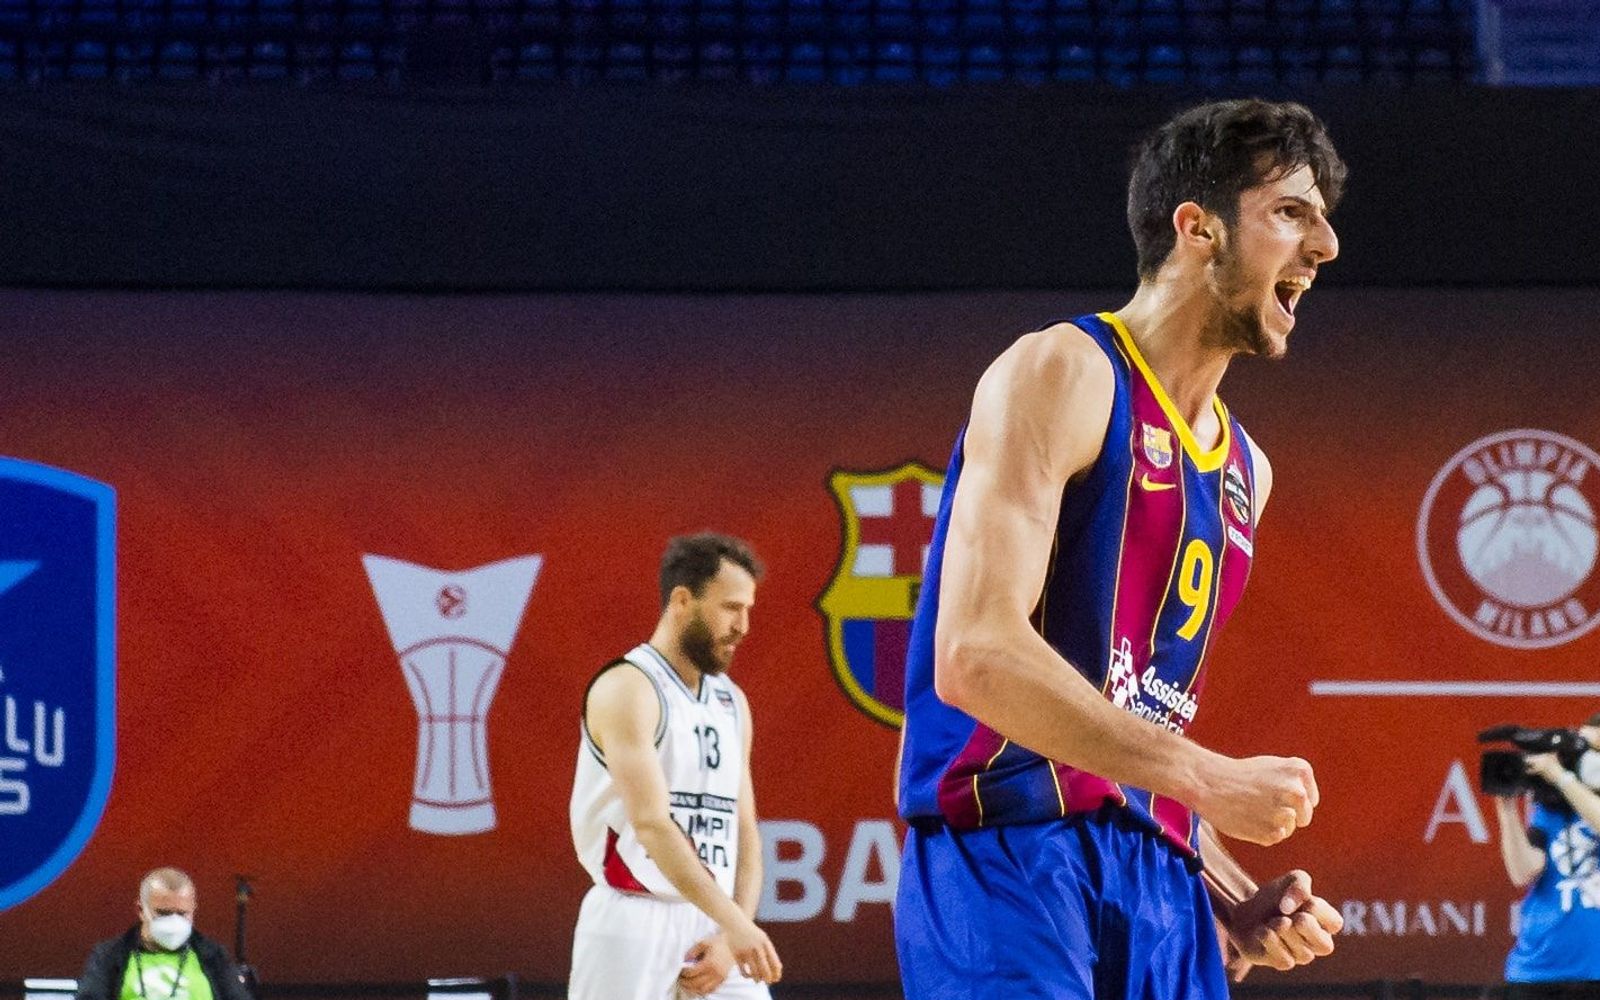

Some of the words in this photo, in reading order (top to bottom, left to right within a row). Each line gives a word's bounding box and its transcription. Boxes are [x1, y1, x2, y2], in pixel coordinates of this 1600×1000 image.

[1461, 441, 1590, 487] OLIMPIA
[1176, 538, 1214, 641] 9
[1472, 597, 1590, 638] MILANO
[694, 725, 721, 770] 13
[1341, 900, 1486, 937] RMANI
